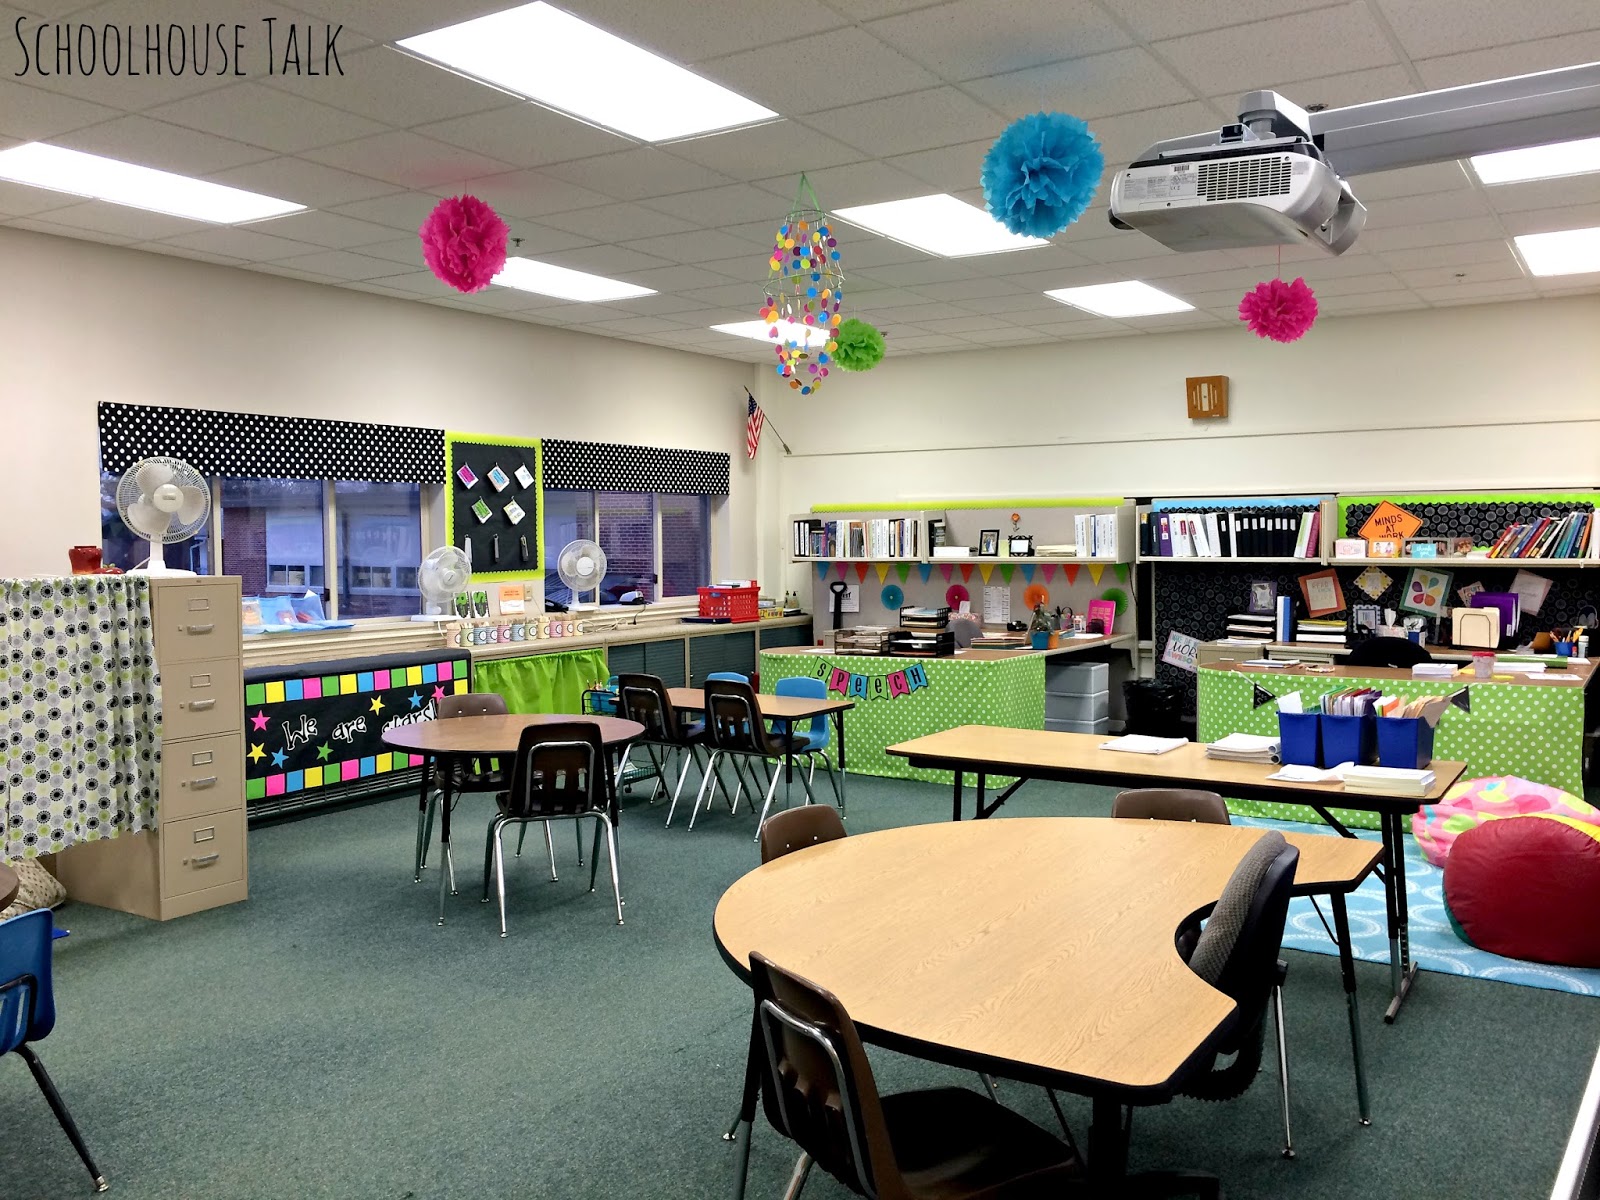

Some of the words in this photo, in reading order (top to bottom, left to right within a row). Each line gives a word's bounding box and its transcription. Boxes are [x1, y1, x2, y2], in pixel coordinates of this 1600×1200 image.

[1374, 513, 1402, 526] MINDS
[1385, 524, 1395, 533] AT
[1169, 641, 1197, 658] MOR
[282, 714, 318, 750] We
[332, 716, 367, 743] are
